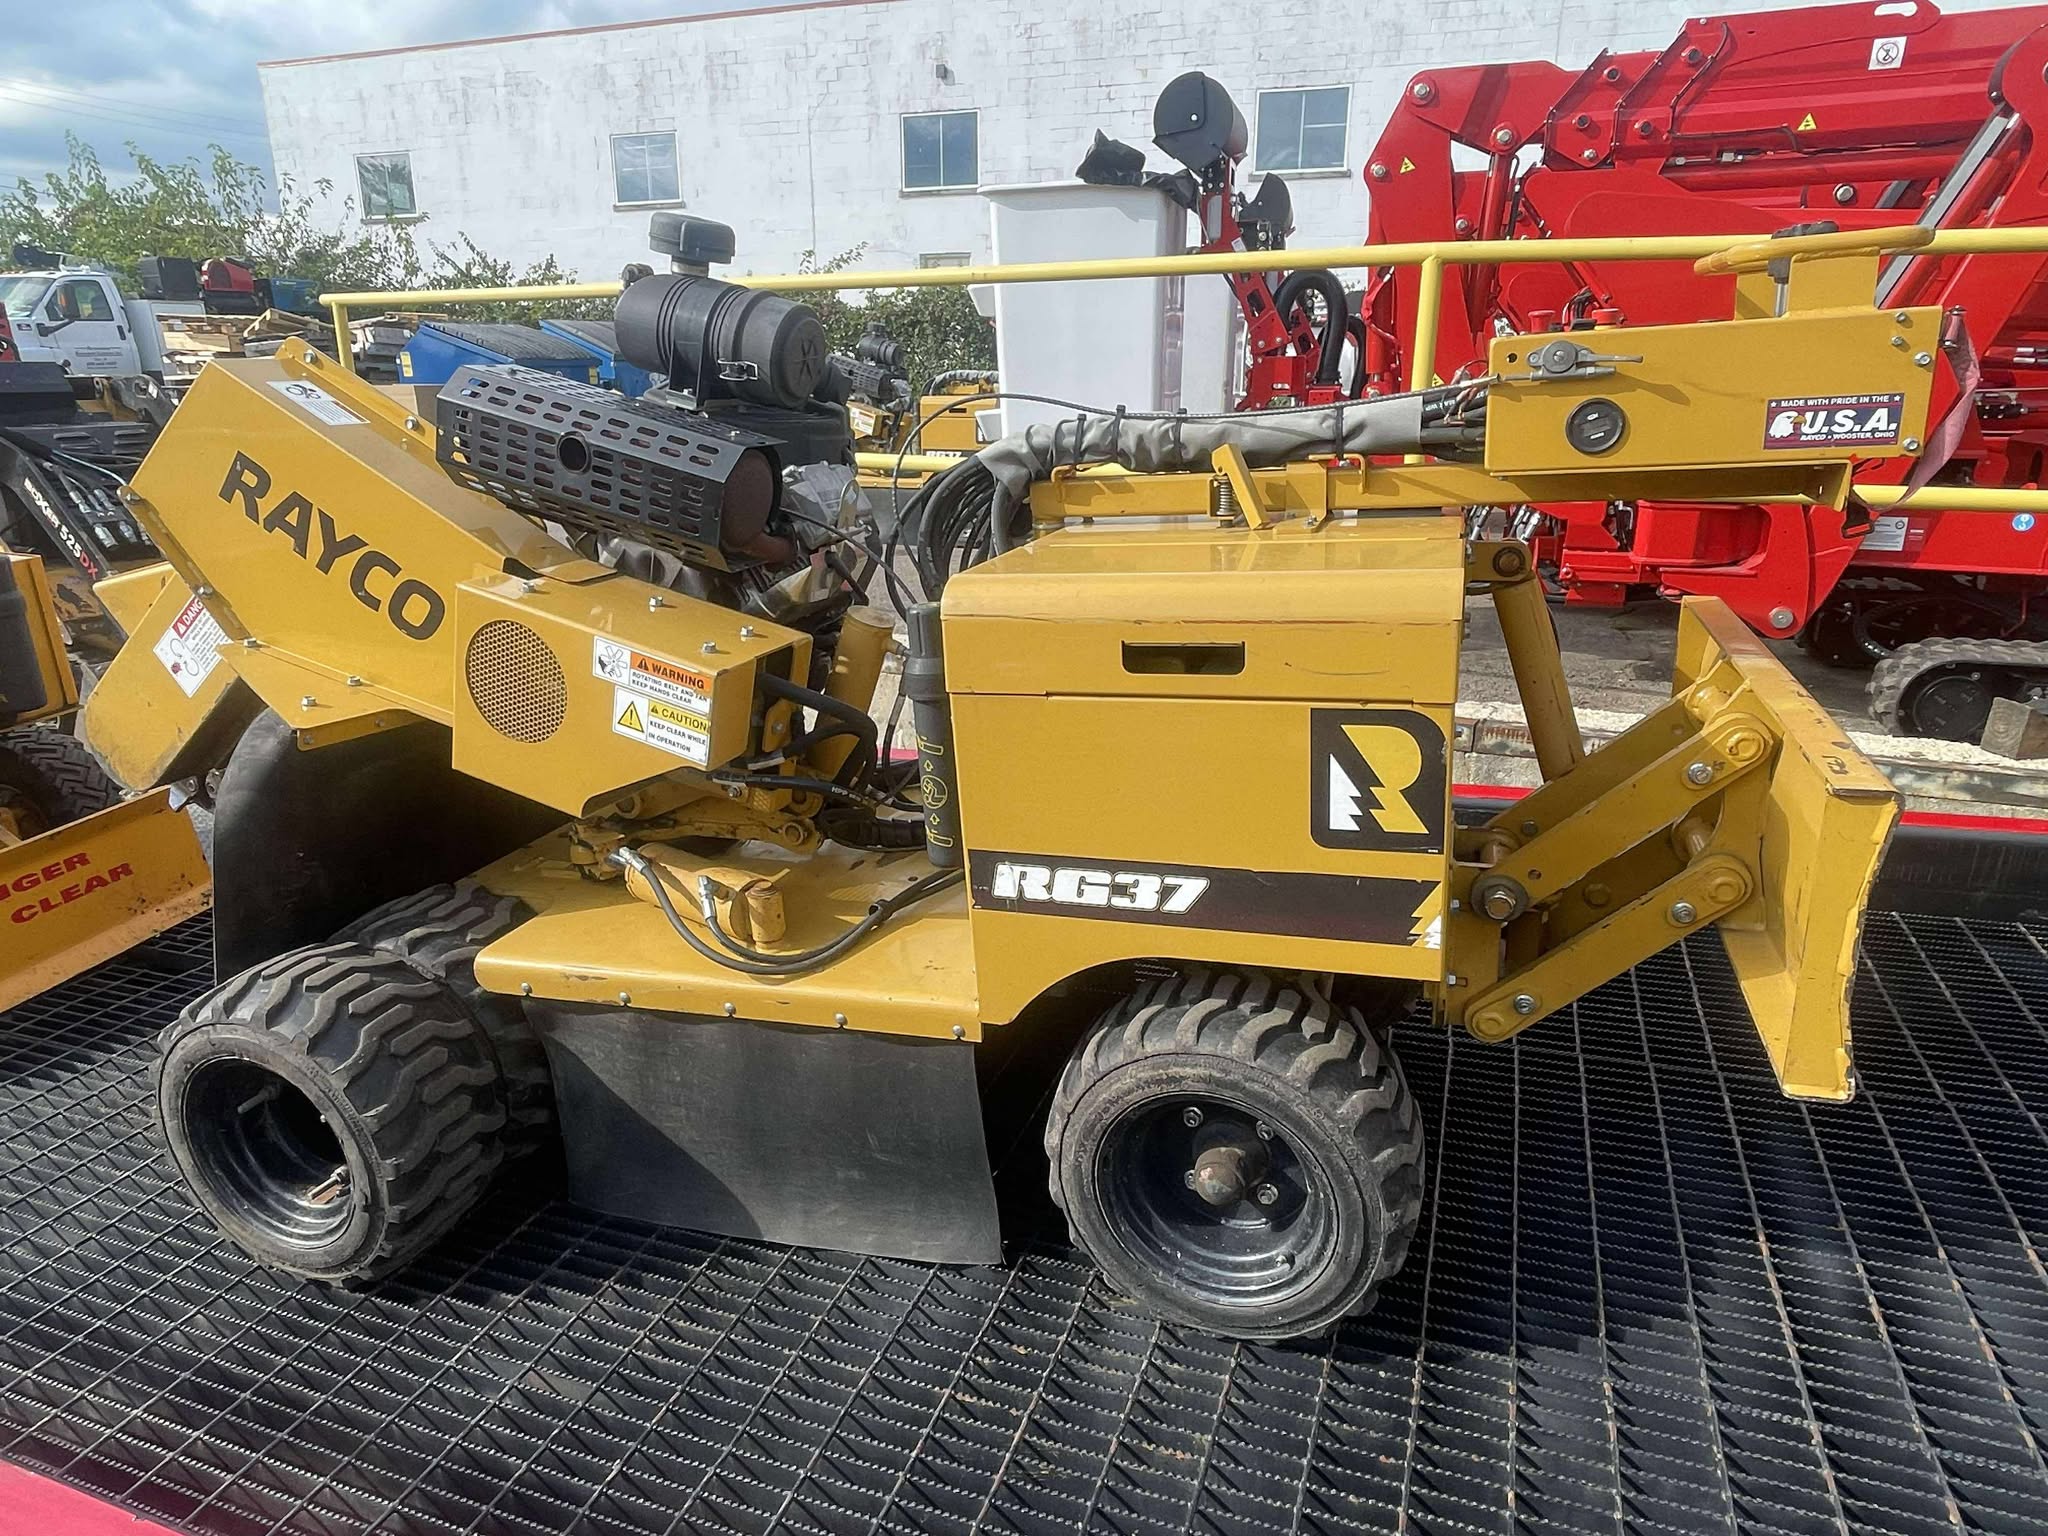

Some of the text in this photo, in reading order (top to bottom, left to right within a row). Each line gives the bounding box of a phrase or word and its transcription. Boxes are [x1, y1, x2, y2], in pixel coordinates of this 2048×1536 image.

[1781, 395, 1889, 407] MADE WITH PRIDE IN THE
[1801, 408, 1898, 434] U.S.A.
[59, 524, 98, 580] 525DX
[218, 450, 446, 641] RAYCO
[182, 597, 203, 626] DANG
[632, 671, 663, 686] ROTATING
[663, 682, 679, 692] BELT
[680, 688, 694, 697] AND
[652, 663, 705, 690] WARNING
[632, 679, 692, 704] KEEP HANDS CLEAR
[650, 720, 706, 745] KEEP CLEAR WHILE
[662, 708, 707, 731] CAUTION
[656, 735, 691, 752] OPERATION
[0, 852, 91, 901] GER
[992, 862, 1209, 914] RG37
[10, 862, 134, 924] CLEAR
